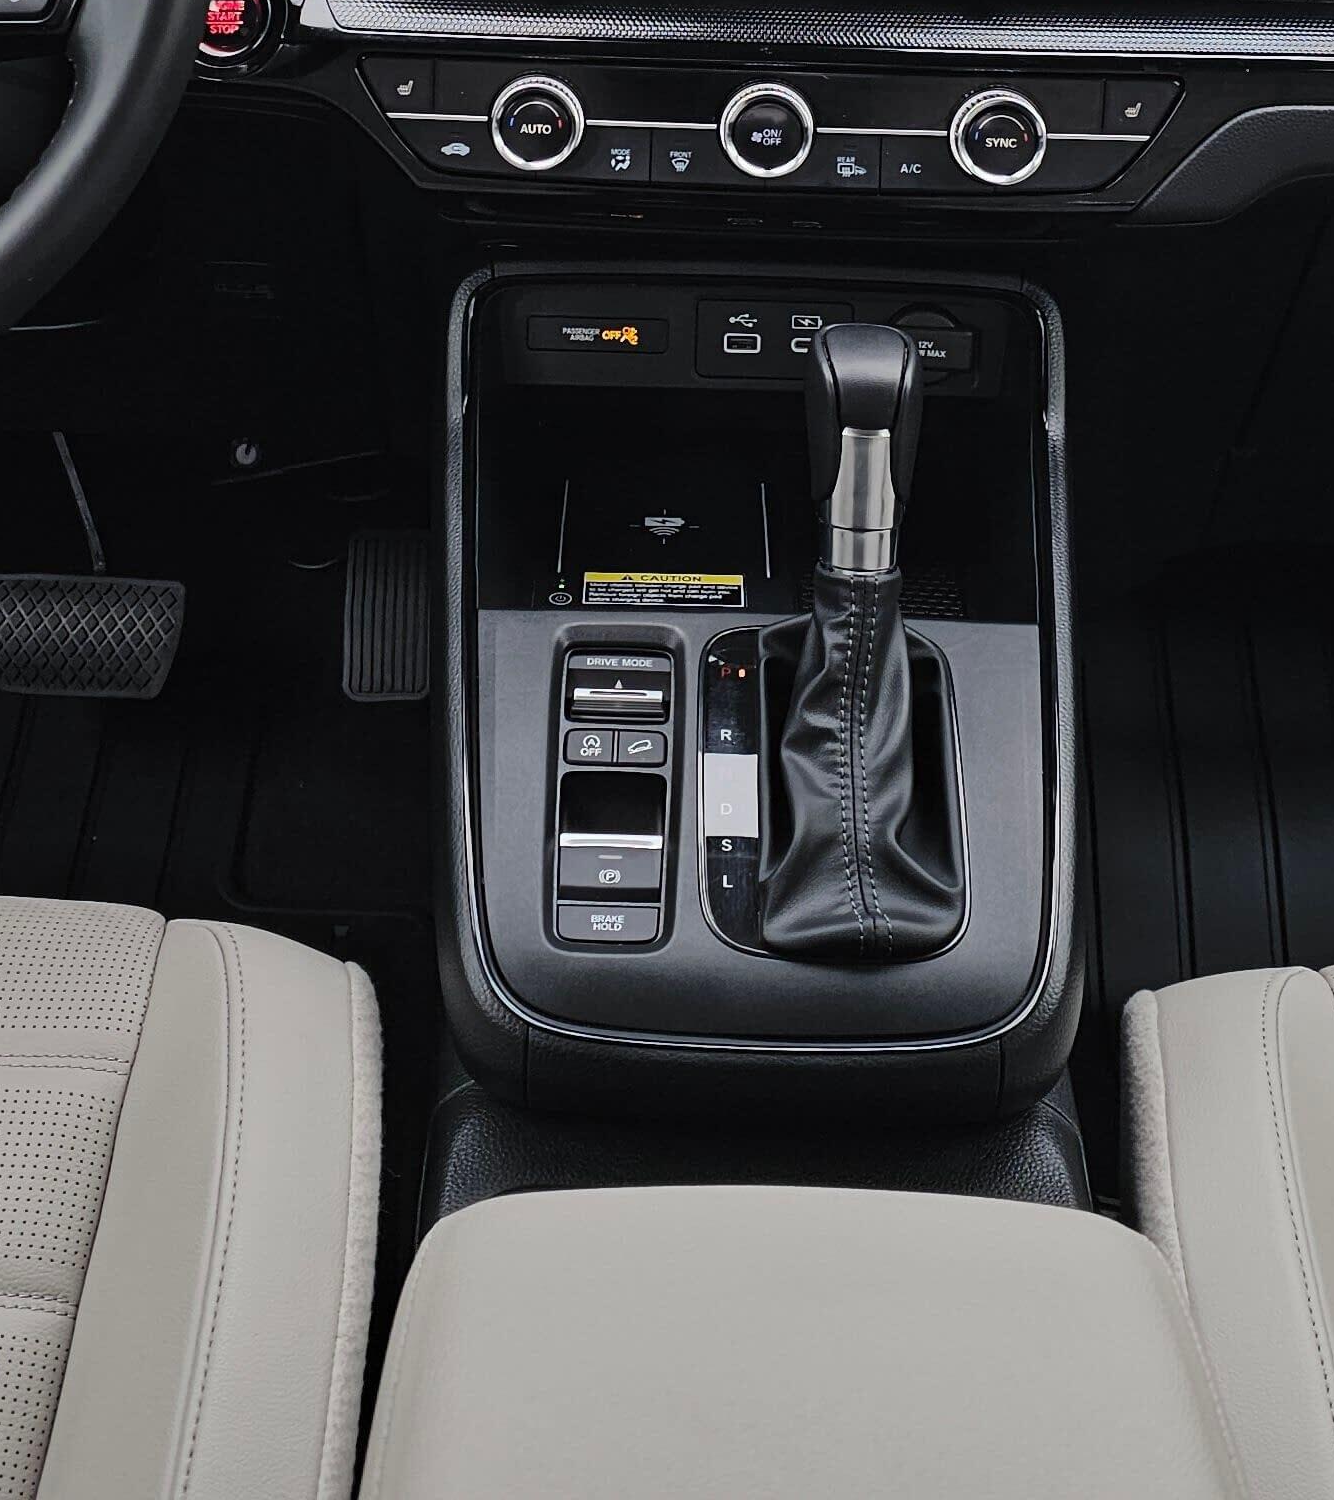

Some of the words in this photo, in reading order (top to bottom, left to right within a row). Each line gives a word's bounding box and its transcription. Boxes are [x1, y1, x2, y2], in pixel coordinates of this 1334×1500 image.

[208, 11, 242, 21] START
[209, 24, 240, 34] STOP
[519, 123, 552, 135] AUTO
[763, 138, 782, 146] OFF
[985, 137, 1017, 148] SYNC
[610, 148, 631, 156] MODE
[900, 163, 922, 174] A/C
[562, 327, 600, 335] PASSENGER
[601, 330, 622, 341] OFF
[927, 350, 947, 358] MAX
[586, 657, 618, 667] DRIVE
[622, 658, 654, 668] MODE
[720, 667, 732, 678] P
[720, 728, 733, 741] R
[580, 748, 602, 757] OFF
[720, 803, 733, 815] D
[721, 839, 733, 852] S
[722, 874, 734, 888] L
[590, 914, 625, 924] BRAKE
[592, 922, 623, 932] HOLD
